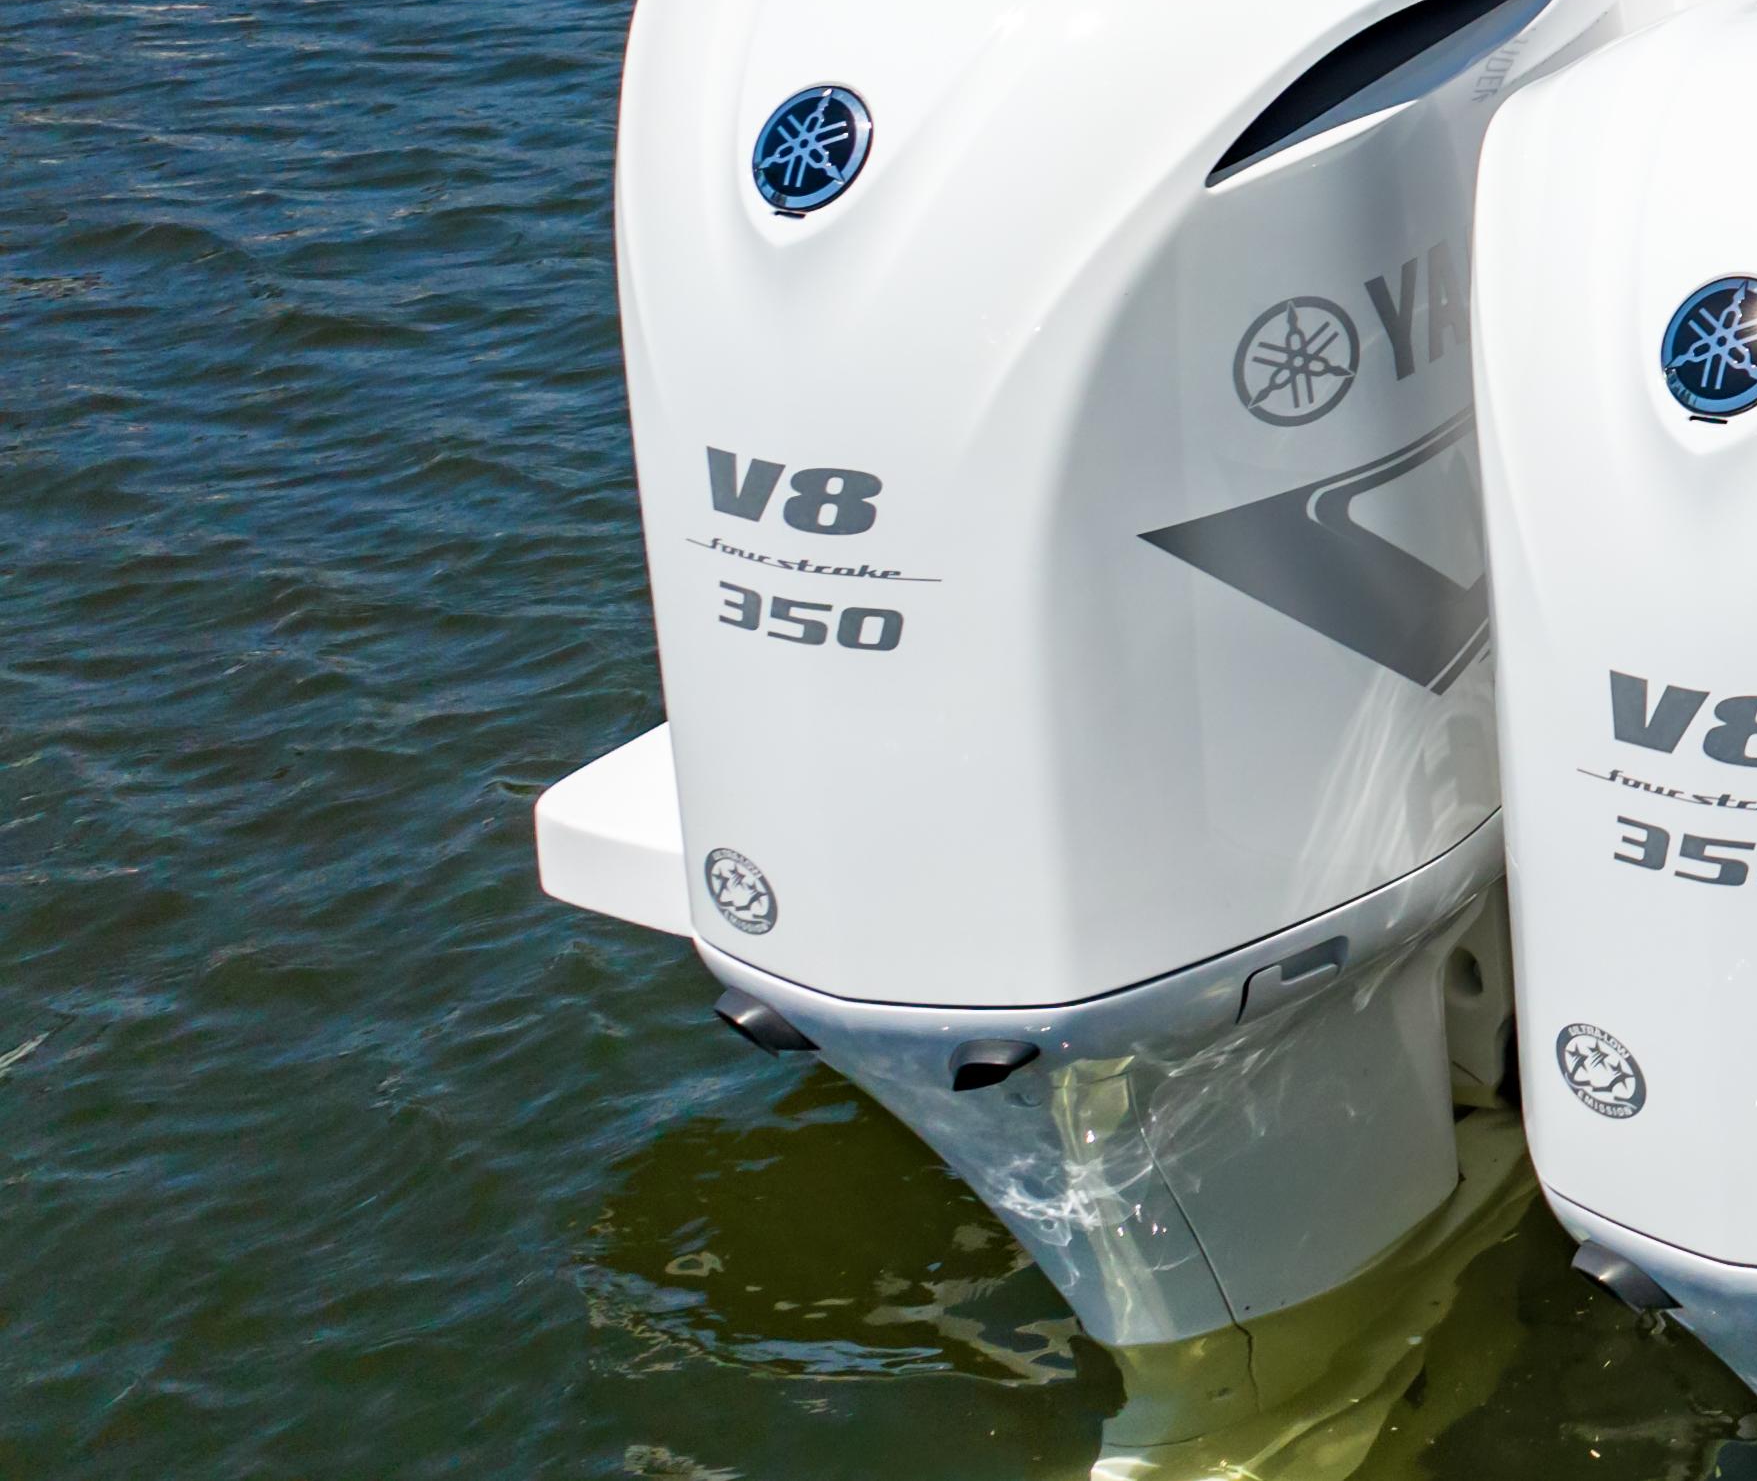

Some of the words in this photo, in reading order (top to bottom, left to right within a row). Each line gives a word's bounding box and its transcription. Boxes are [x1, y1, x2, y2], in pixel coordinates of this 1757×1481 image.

[706, 445, 884, 536] V8
[708, 536, 771, 564] four
[777, 558, 902, 580] stroke
[718, 579, 905, 652] 350
[1607, 768, 1685, 799] four
[1577, 1089, 1633, 1117] EMISSION
